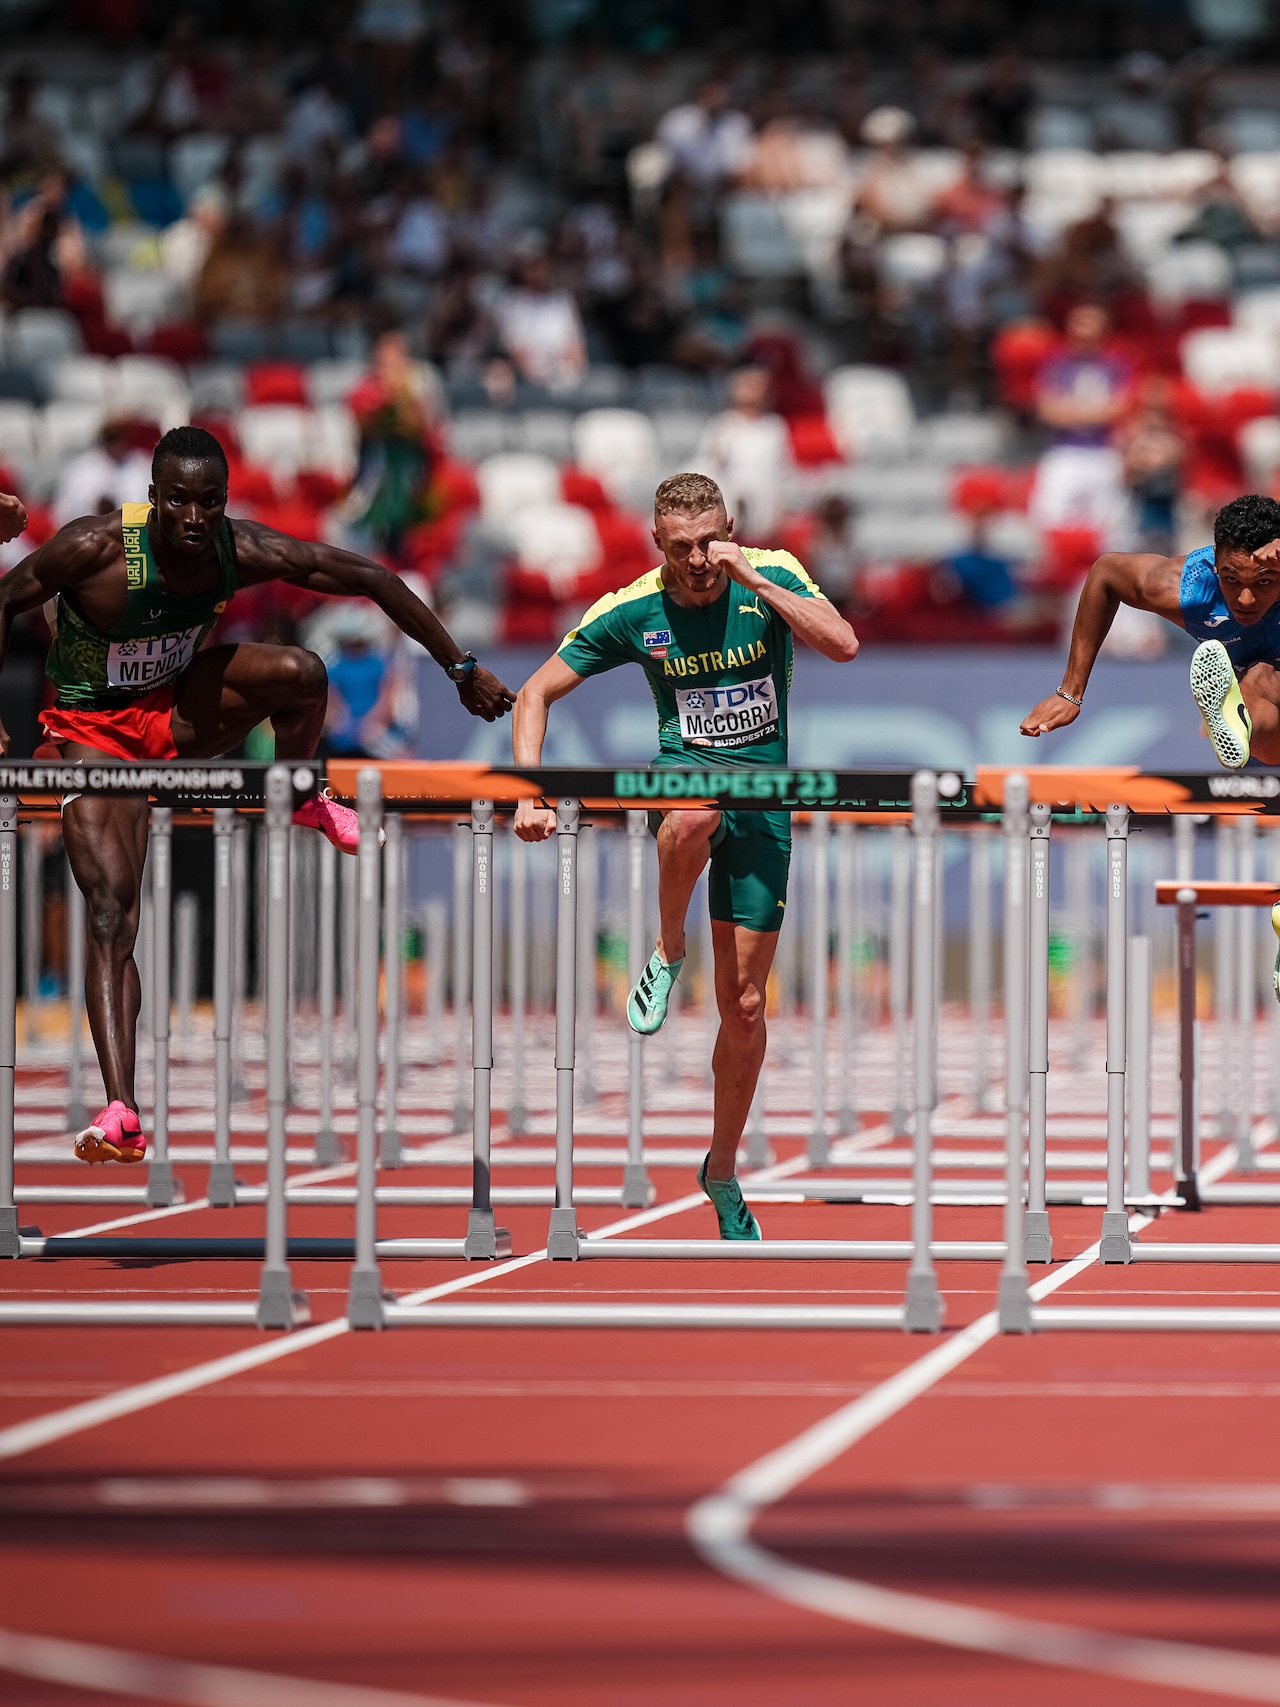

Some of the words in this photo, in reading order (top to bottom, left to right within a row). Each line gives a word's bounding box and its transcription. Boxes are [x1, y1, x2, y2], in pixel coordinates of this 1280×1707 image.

[119, 645, 188, 682] MENDY
[663, 640, 767, 677] AUSTRALIA
[703, 680, 771, 708] TDK
[686, 701, 773, 735] McCORRY
[714, 729, 764, 748] BUDAPEST
[765, 725, 776, 737] 23
[88, 768, 245, 790] CHAMPIONSHIPS
[614, 770, 793, 798] BUDAPEST
[796, 770, 837, 798] 23
[1207, 776, 1280, 798] WORLD
[1, 853, 11, 891] MONDO
[477, 856, 488, 894] MONDO
[561, 857, 572, 895] MONDO
[1034, 861, 1045, 898] MONDO
[1111, 860, 1122, 898] MONDO
